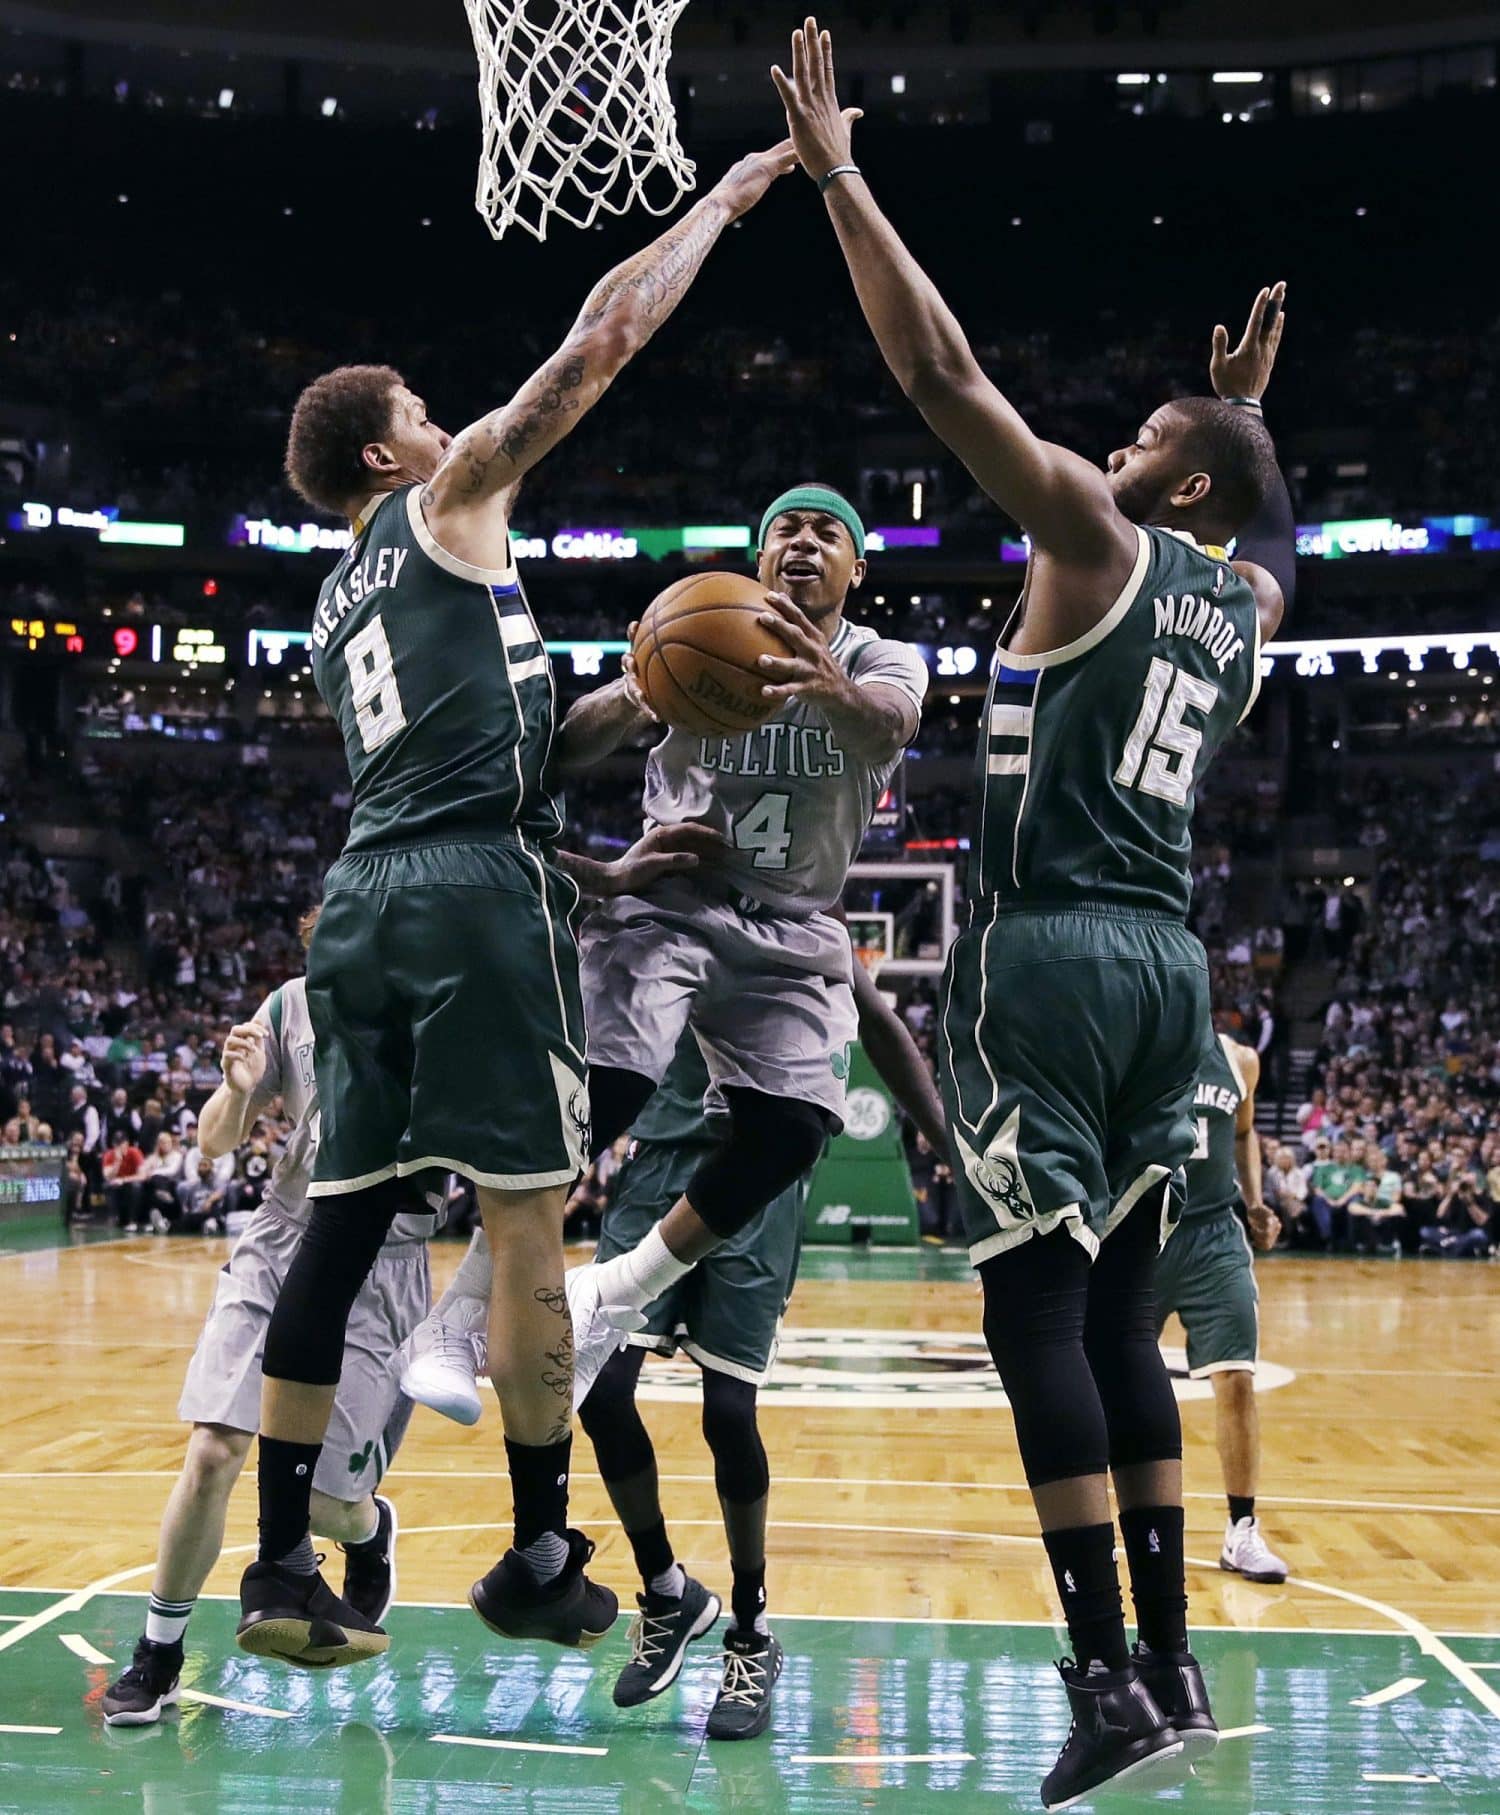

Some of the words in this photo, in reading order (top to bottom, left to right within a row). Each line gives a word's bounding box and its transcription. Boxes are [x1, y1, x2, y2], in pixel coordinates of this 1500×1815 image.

[245, 519, 295, 546] The
[313, 548, 408, 649] BEASLEY
[1153, 595, 1245, 674] MONROE
[700, 722, 844, 777] CELTICS
[1113, 657, 1218, 806] 15
[732, 792, 792, 871] 4
